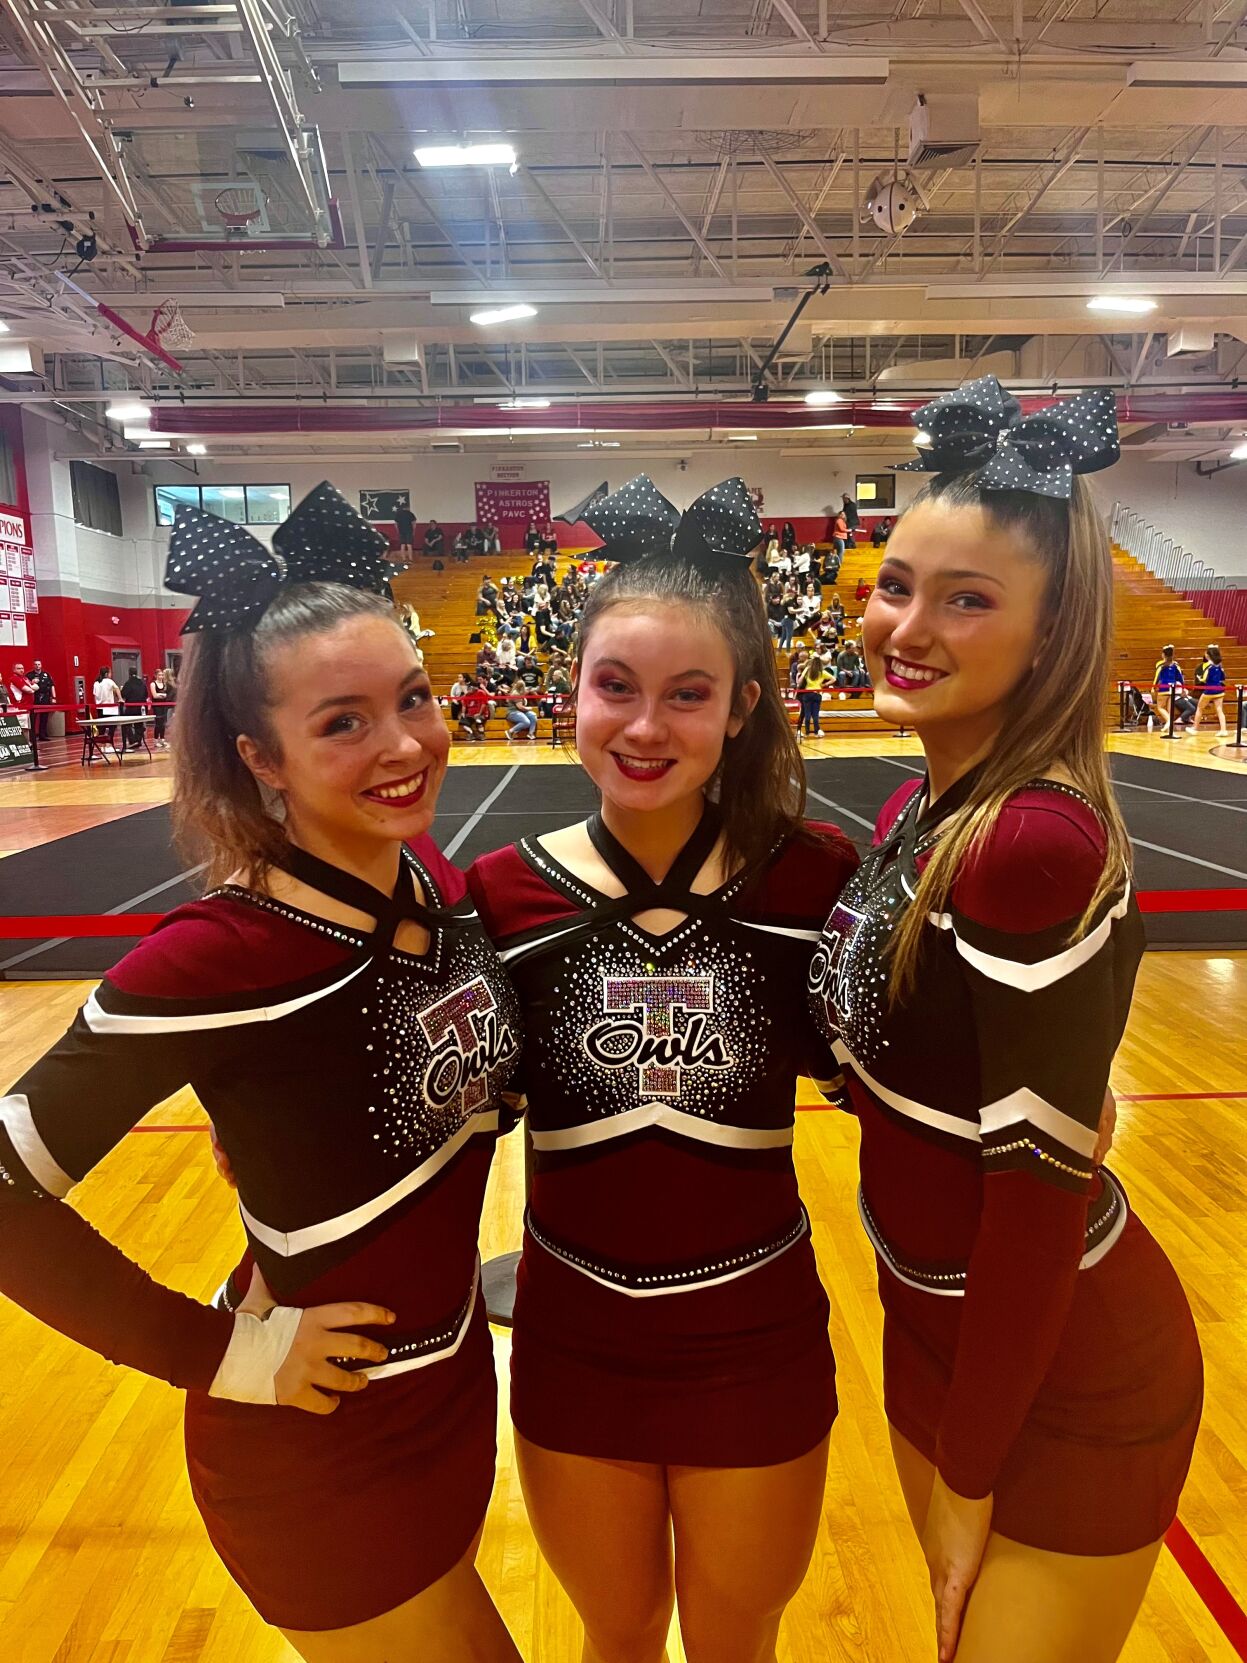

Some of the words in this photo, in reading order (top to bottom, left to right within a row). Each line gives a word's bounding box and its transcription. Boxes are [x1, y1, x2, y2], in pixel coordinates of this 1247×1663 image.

[487, 489, 539, 497] PINKERTON
[498, 499, 533, 507] ASTROS
[416, 974, 498, 1116] T
[424, 1012, 518, 1109] Owls
[583, 1013, 734, 1069] Owls
[603, 976, 714, 1096] T
